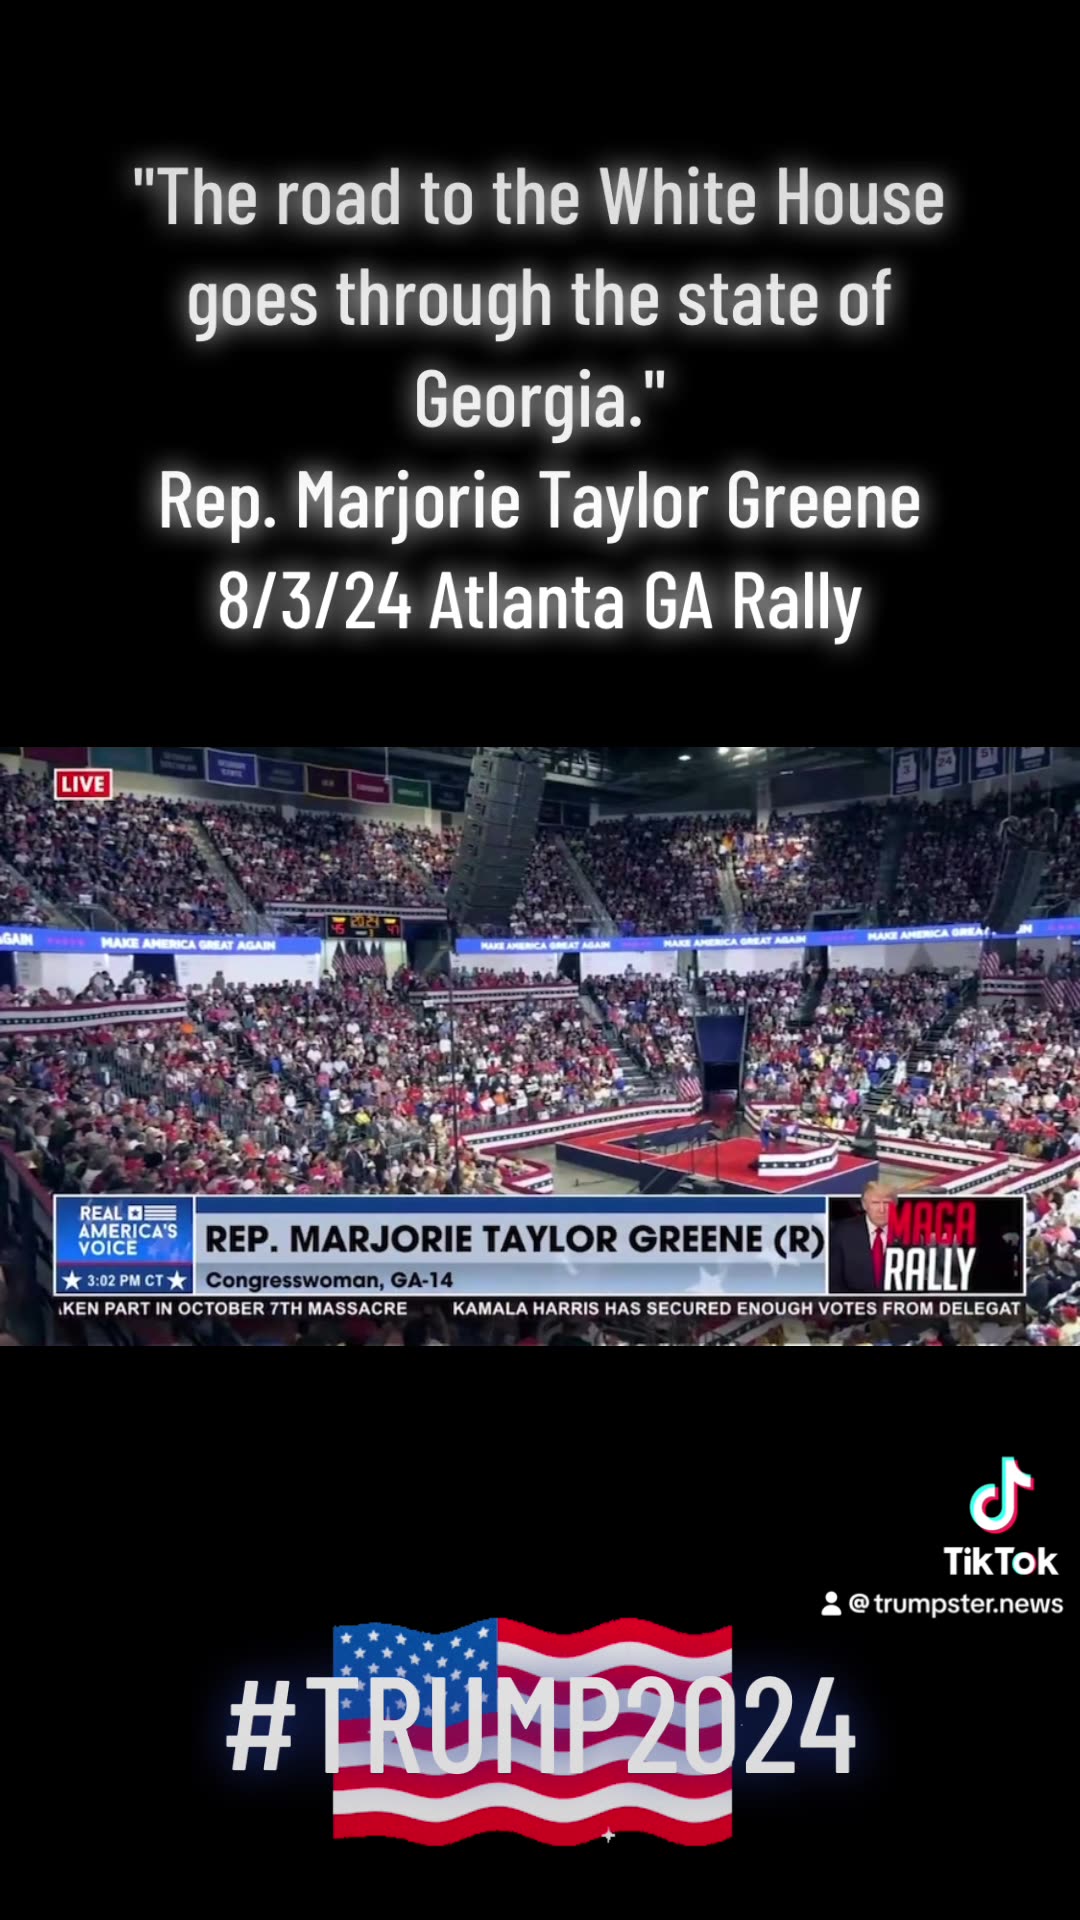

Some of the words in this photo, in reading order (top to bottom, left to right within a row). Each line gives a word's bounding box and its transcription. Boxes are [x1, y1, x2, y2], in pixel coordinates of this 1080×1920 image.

[867, 931, 898, 941] MAKE
[901, 929, 948, 940] AMERICA
[101, 937, 139, 949] MAKE
[143, 938, 196, 950] AMERICA
[199, 939, 234, 951] GREAT
[237, 940, 276, 951] AGAIN
[481, 942, 505, 950] MAKE
[506, 942, 547, 951] AMERICA
[549, 941, 580, 950] GREAT
[582, 941, 611, 950] AGAIN
[663, 939, 691, 948] MAKE
[693, 938, 737, 947] AMERICA
[740, 936, 771, 946] GREAT
[774, 935, 807, 945] AGAIN
